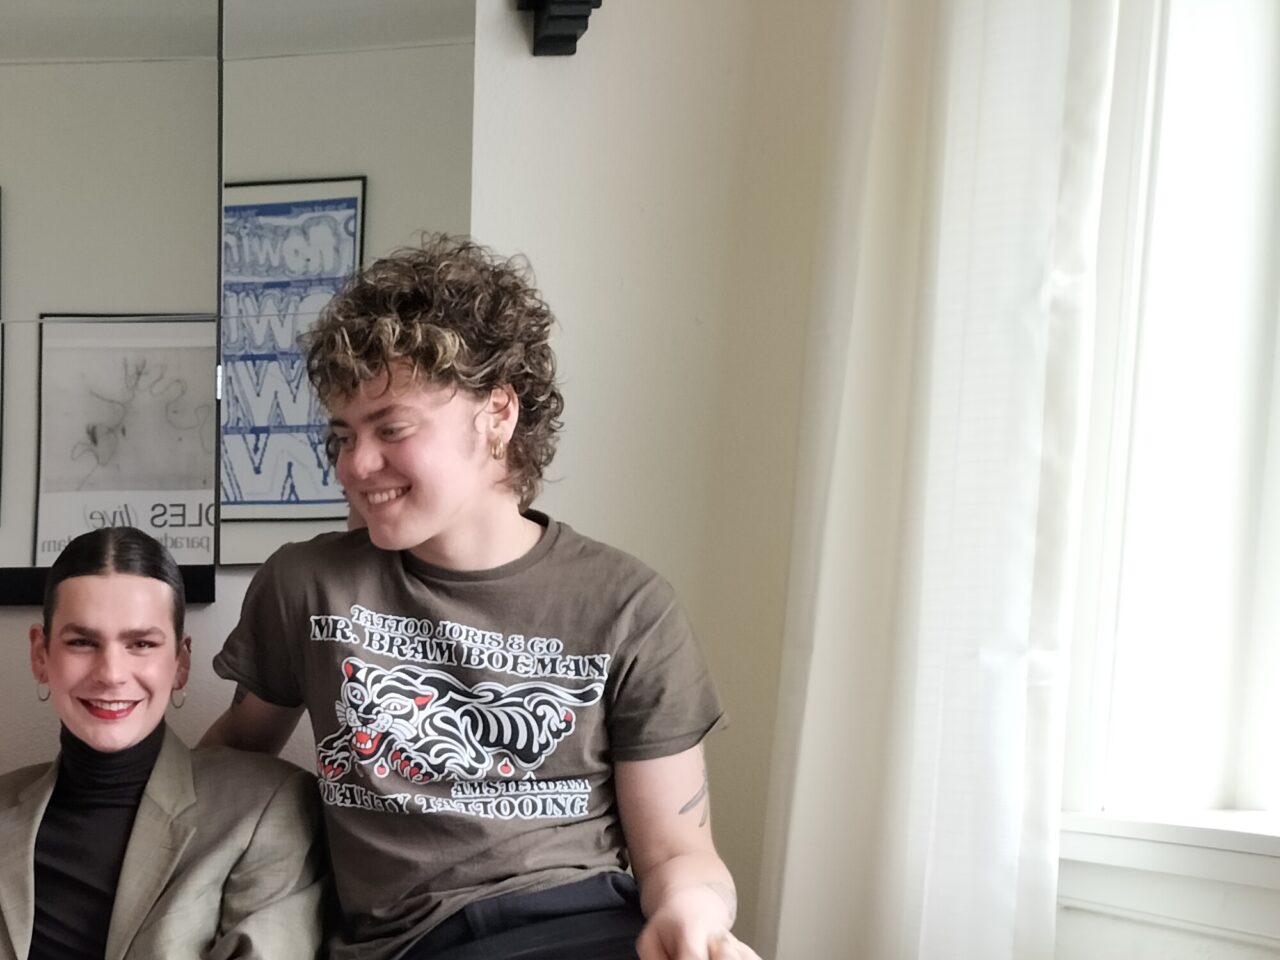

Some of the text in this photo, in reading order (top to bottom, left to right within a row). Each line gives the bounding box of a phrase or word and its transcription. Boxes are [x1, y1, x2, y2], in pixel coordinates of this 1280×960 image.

[310, 615, 610, 681] MR. BRAM BOEMAN
[350, 604, 433, 637] TATTOO
[435, 620, 504, 649] JORIS
[507, 635, 525, 653] &
[414, 793, 589, 820] TATTOOING
